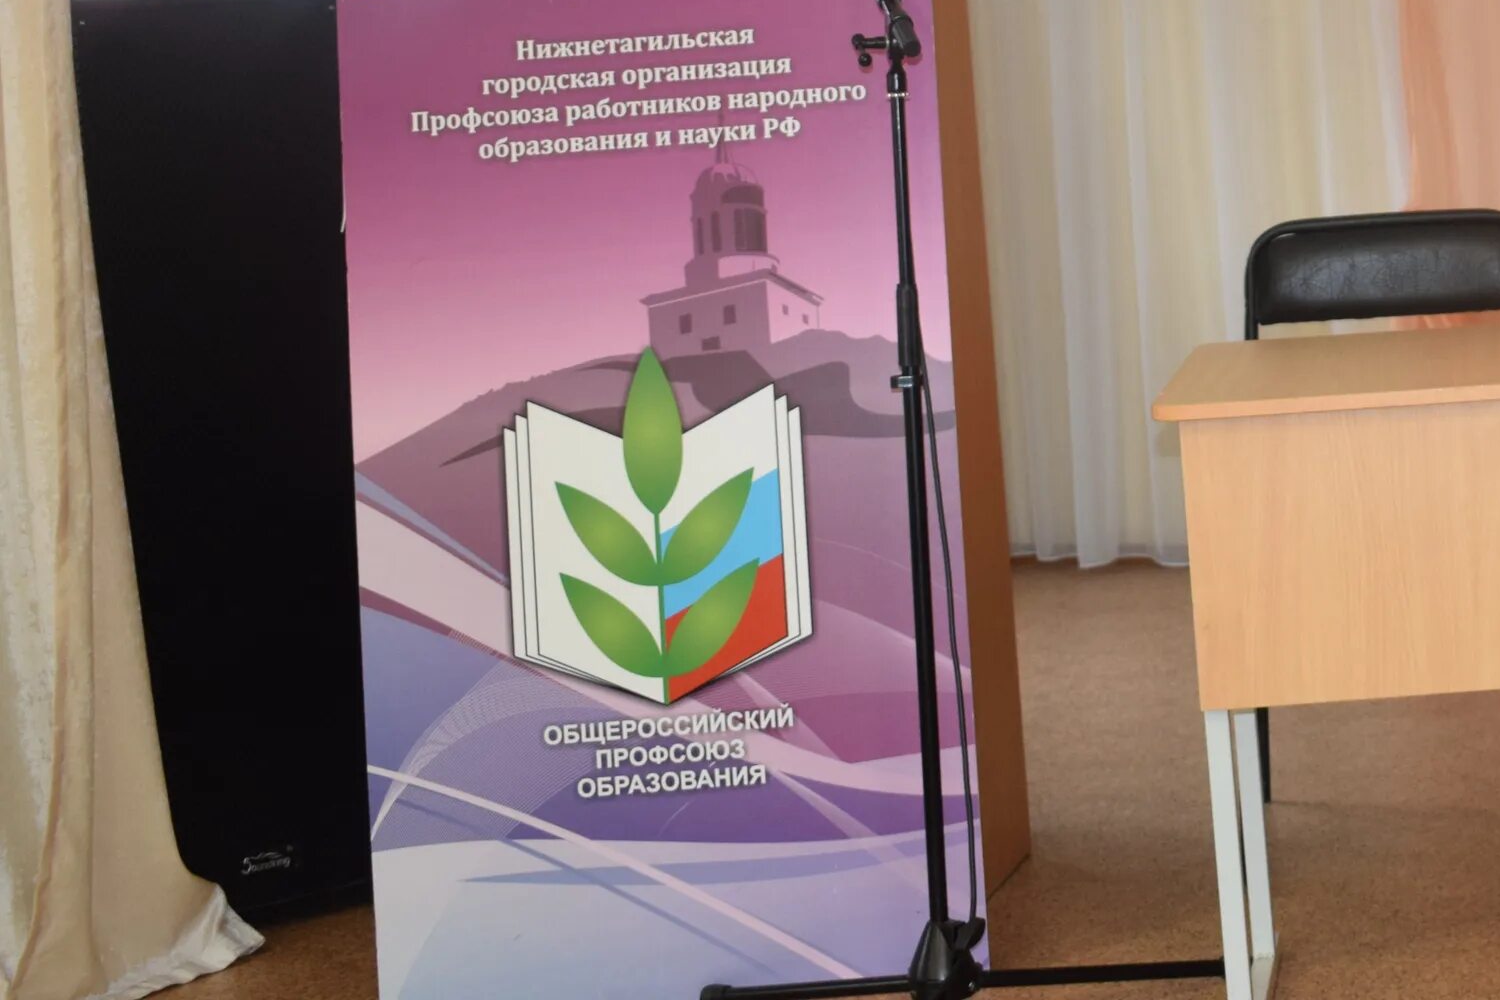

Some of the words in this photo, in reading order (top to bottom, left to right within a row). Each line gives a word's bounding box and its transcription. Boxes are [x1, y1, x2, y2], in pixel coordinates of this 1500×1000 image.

[515, 27, 756, 62] Нижнетагильская
[481, 69, 616, 99] городская
[620, 55, 793, 91] организация
[410, 105, 560, 137] Профсоюза
[564, 94, 723, 128] работников
[727, 83, 868, 113] народного
[477, 131, 649, 163] образования
[655, 129, 672, 147] и
[677, 123, 756, 149] науки
[762, 115, 802, 139] РФ
[543, 704, 795, 746] ОБЩЕРОССИЙСКИЙ
[595, 738, 746, 769] ПРОФСОЮЗ
[576, 763, 767, 798] ОБРАЗОВАНИЯ
